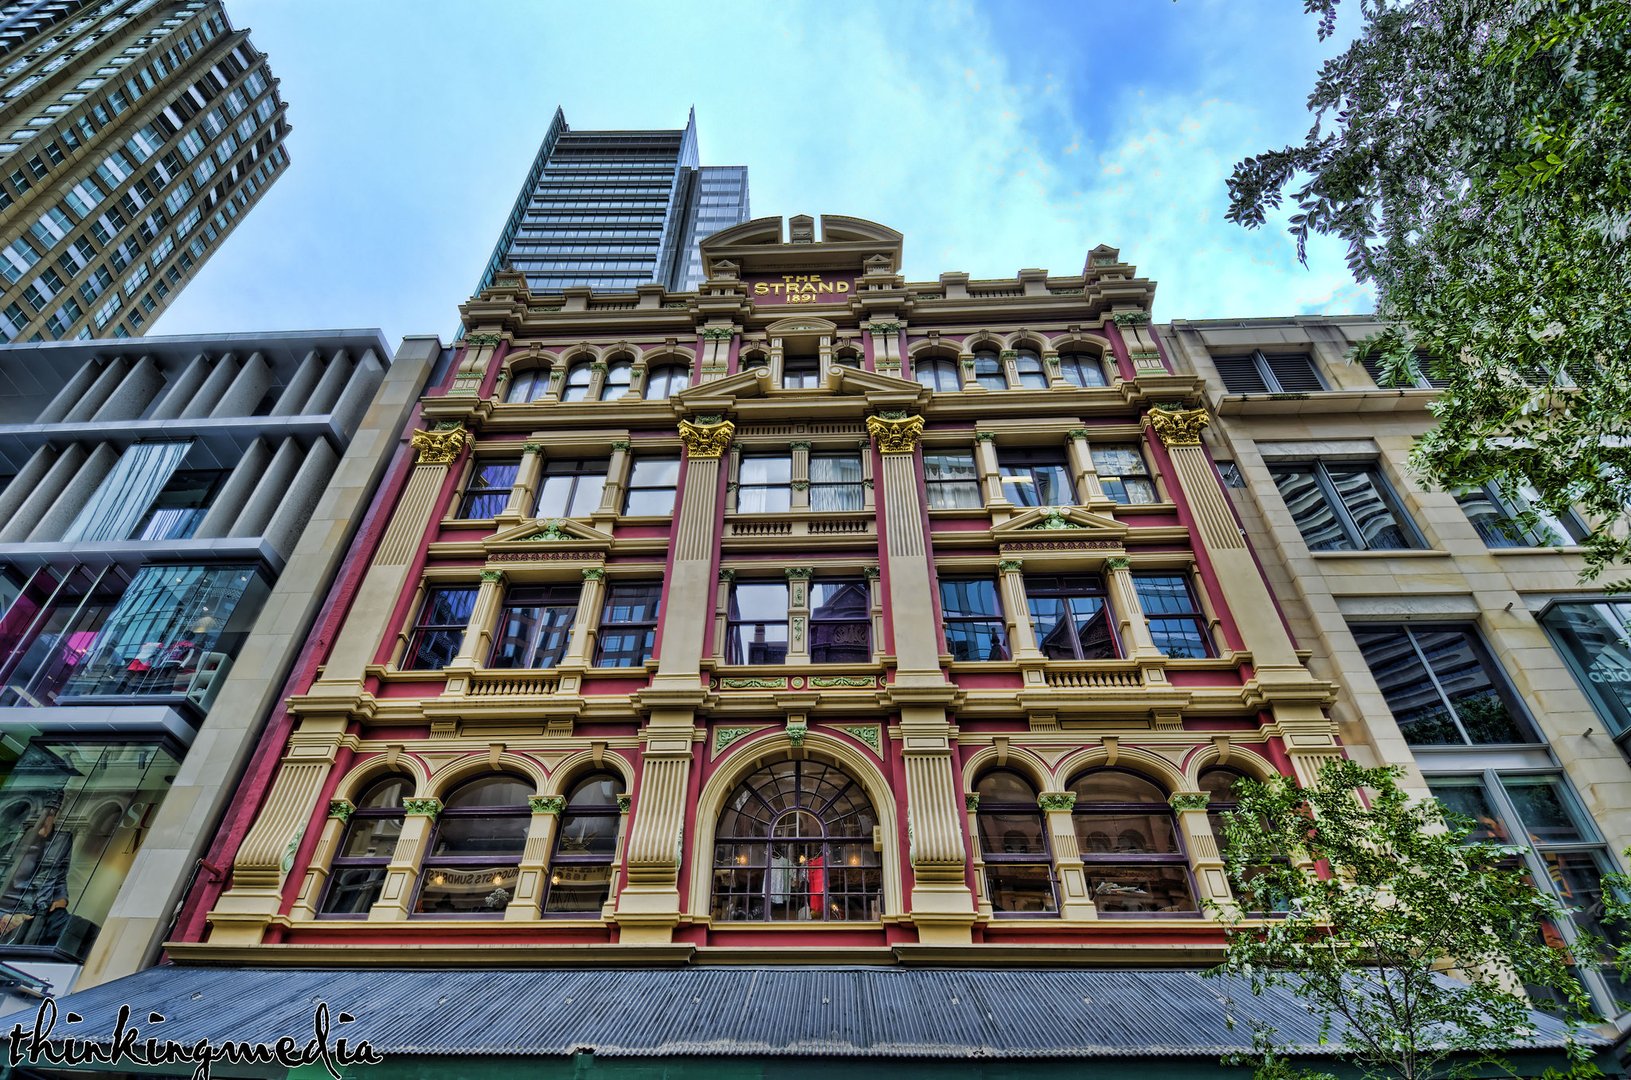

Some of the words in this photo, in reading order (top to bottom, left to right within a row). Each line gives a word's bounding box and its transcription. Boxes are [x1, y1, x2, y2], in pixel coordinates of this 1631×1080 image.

[782, 275, 822, 283] THE
[754, 281, 850, 296] STRAND
[786, 294, 817, 304] 1891
